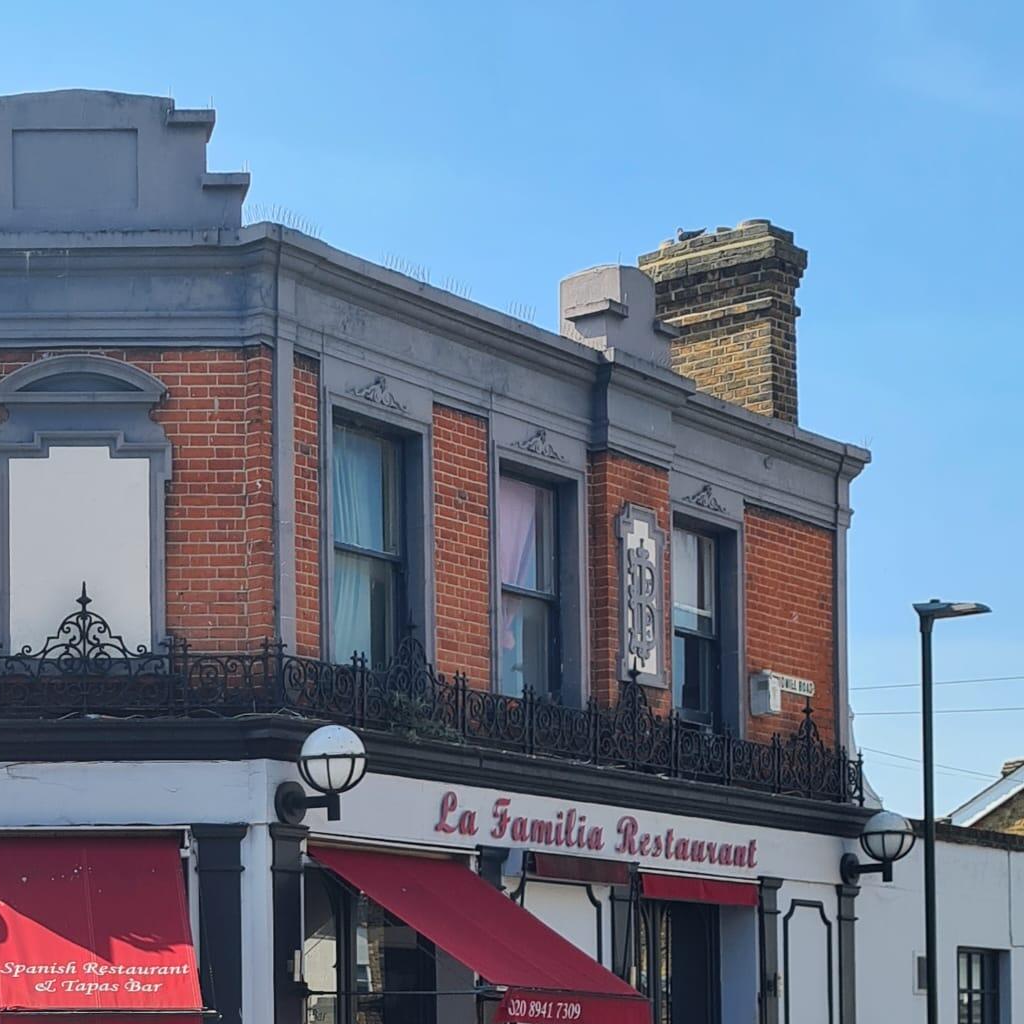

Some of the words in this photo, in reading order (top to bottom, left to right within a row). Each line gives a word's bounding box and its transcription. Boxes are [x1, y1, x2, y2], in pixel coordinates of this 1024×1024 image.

[434, 791, 478, 836] La
[489, 797, 605, 850] Familia
[615, 815, 759, 869] Restaurant
[0, 961, 77, 977] Spanish
[83, 961, 190, 976] Restaurant
[34, 978, 57, 992] &
[61, 979, 119, 995] Tapas
[124, 979, 163, 993] Bar
[528, 1000, 554, 1019] 8941
[556, 1002, 581, 1019] 7309
